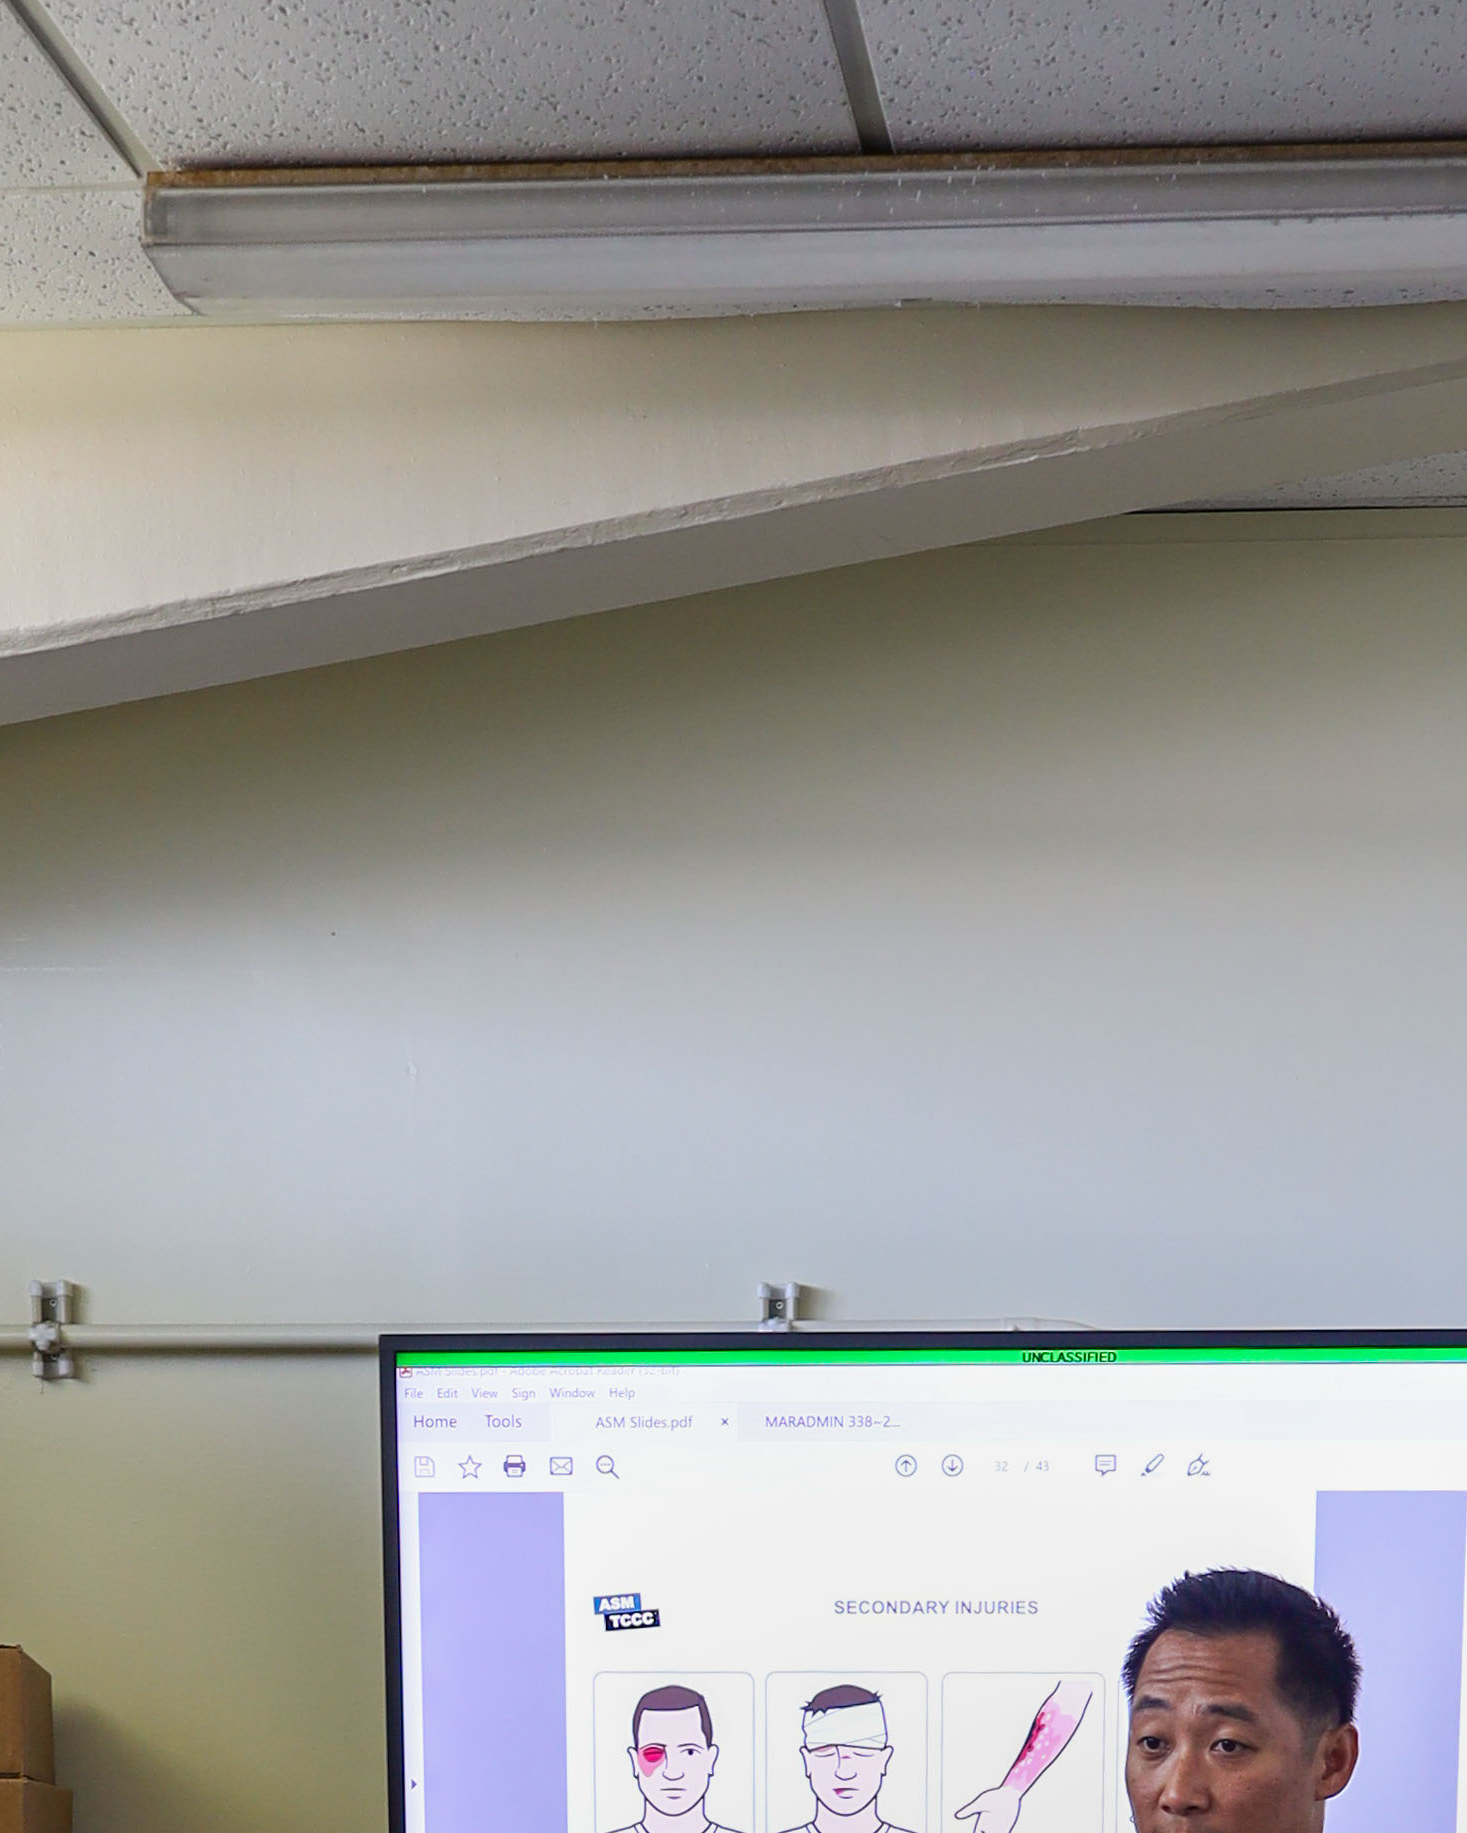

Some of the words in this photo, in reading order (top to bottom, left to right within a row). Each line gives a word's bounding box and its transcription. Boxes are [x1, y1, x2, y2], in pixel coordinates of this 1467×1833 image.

[1022, 1351, 1117, 1363] UNCLASSIFIED
[404, 1387, 423, 1399] File
[437, 1388, 458, 1400] Edit
[471, 1387, 498, 1399] View
[511, 1388, 535, 1401] Sign
[549, 1387, 595, 1399] Window
[609, 1388, 635, 1400] Help
[414, 1415, 457, 1428] Home
[484, 1414, 522, 1429] Tools
[596, 1416, 625, 1428] ASM
[630, 1415, 692, 1431] Slides.pdf
[766, 1416, 843, 1428] MARADMIN
[599, 1597, 635, 1611] ASM
[834, 1600, 949, 1614] SECONDARY
[956, 1601, 1038, 1614] INJURIES
[609, 1612, 654, 1627] TCCC
